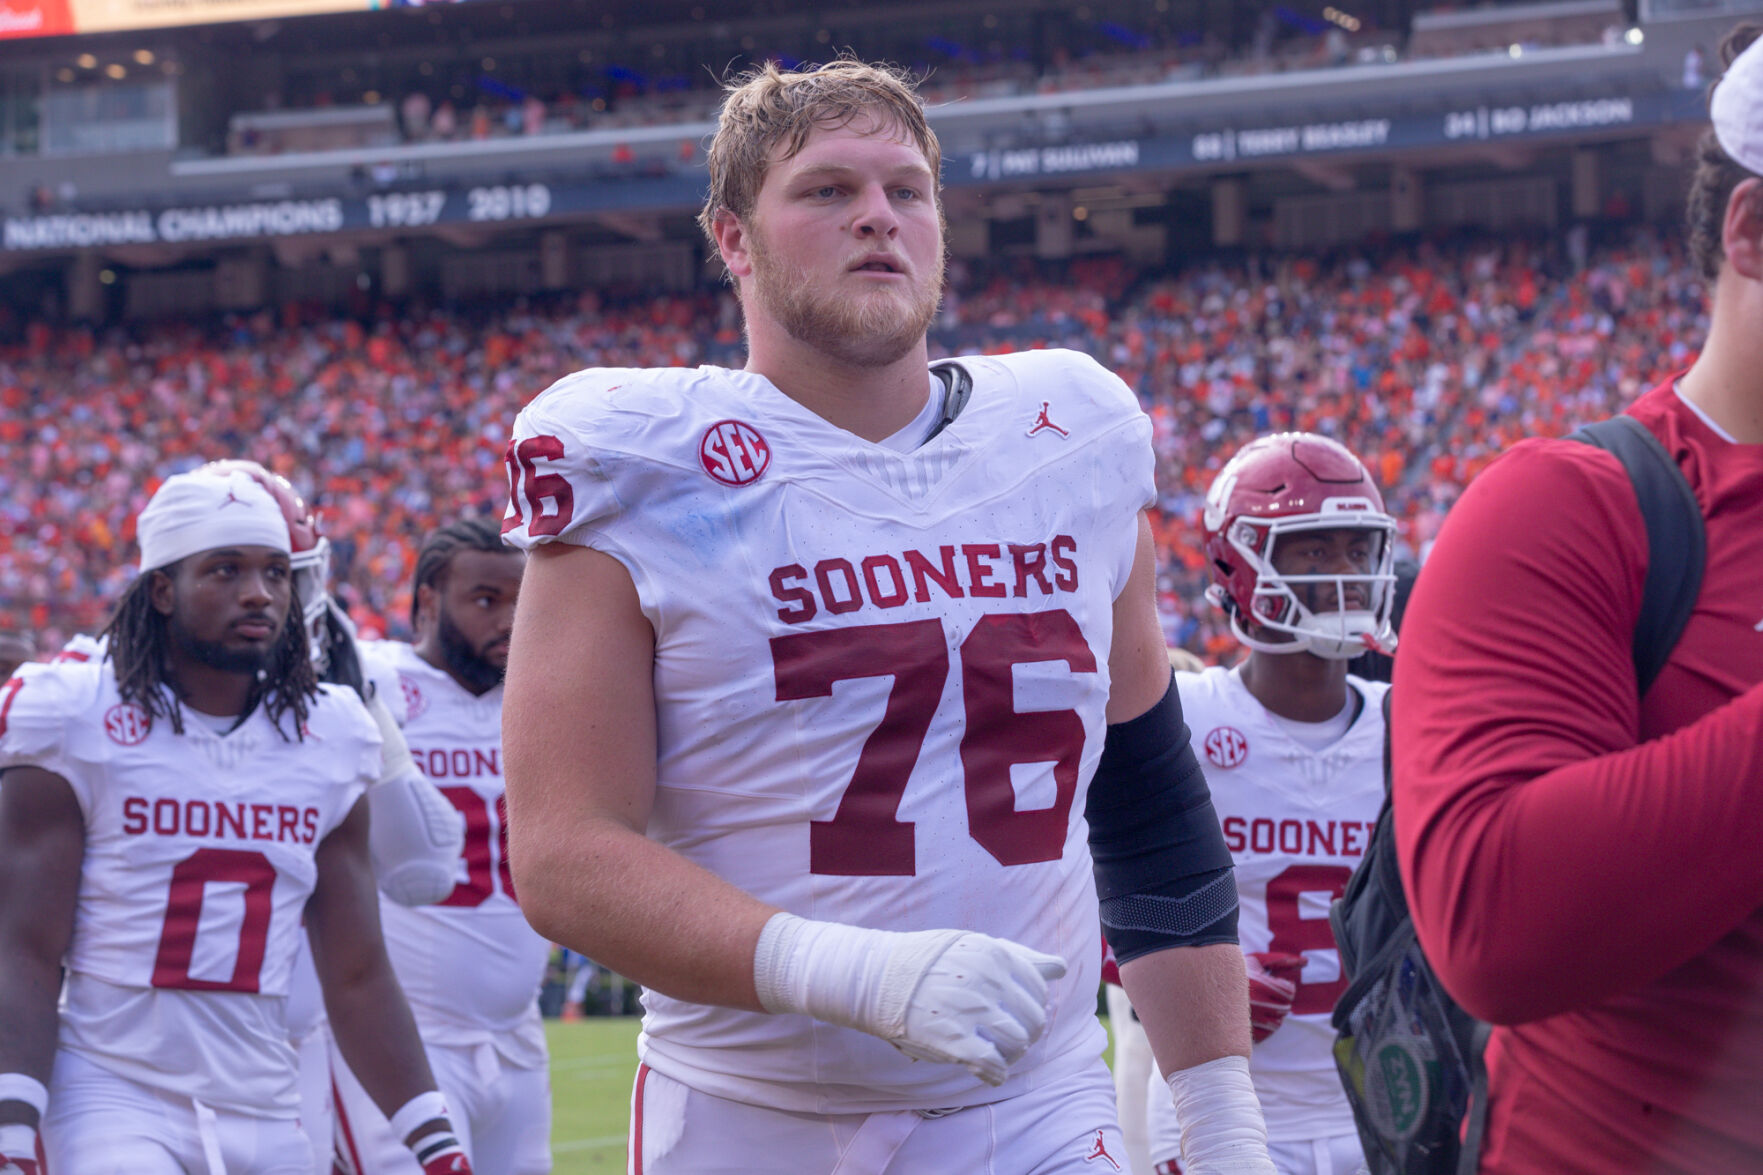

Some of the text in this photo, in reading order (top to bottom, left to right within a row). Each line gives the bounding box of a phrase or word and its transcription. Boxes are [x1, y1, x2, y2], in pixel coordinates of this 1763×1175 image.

[1491, 106, 1527, 134] BO
[1528, 98, 1633, 131] JACKSON
[4, 209, 157, 249] NATIONAL
[157, 198, 343, 242] CHAMPIONS
[467, 183, 550, 221] 2010
[702, 422, 768, 483] SEC
[769, 534, 1078, 624] SOONERS
[410, 749, 504, 777] SOON
[769, 609, 1097, 876] 76
[1205, 727, 1247, 768] SEC
[123, 797, 320, 844] SOONERS
[1223, 817, 1374, 856] SOONE
[151, 847, 277, 994] 0
